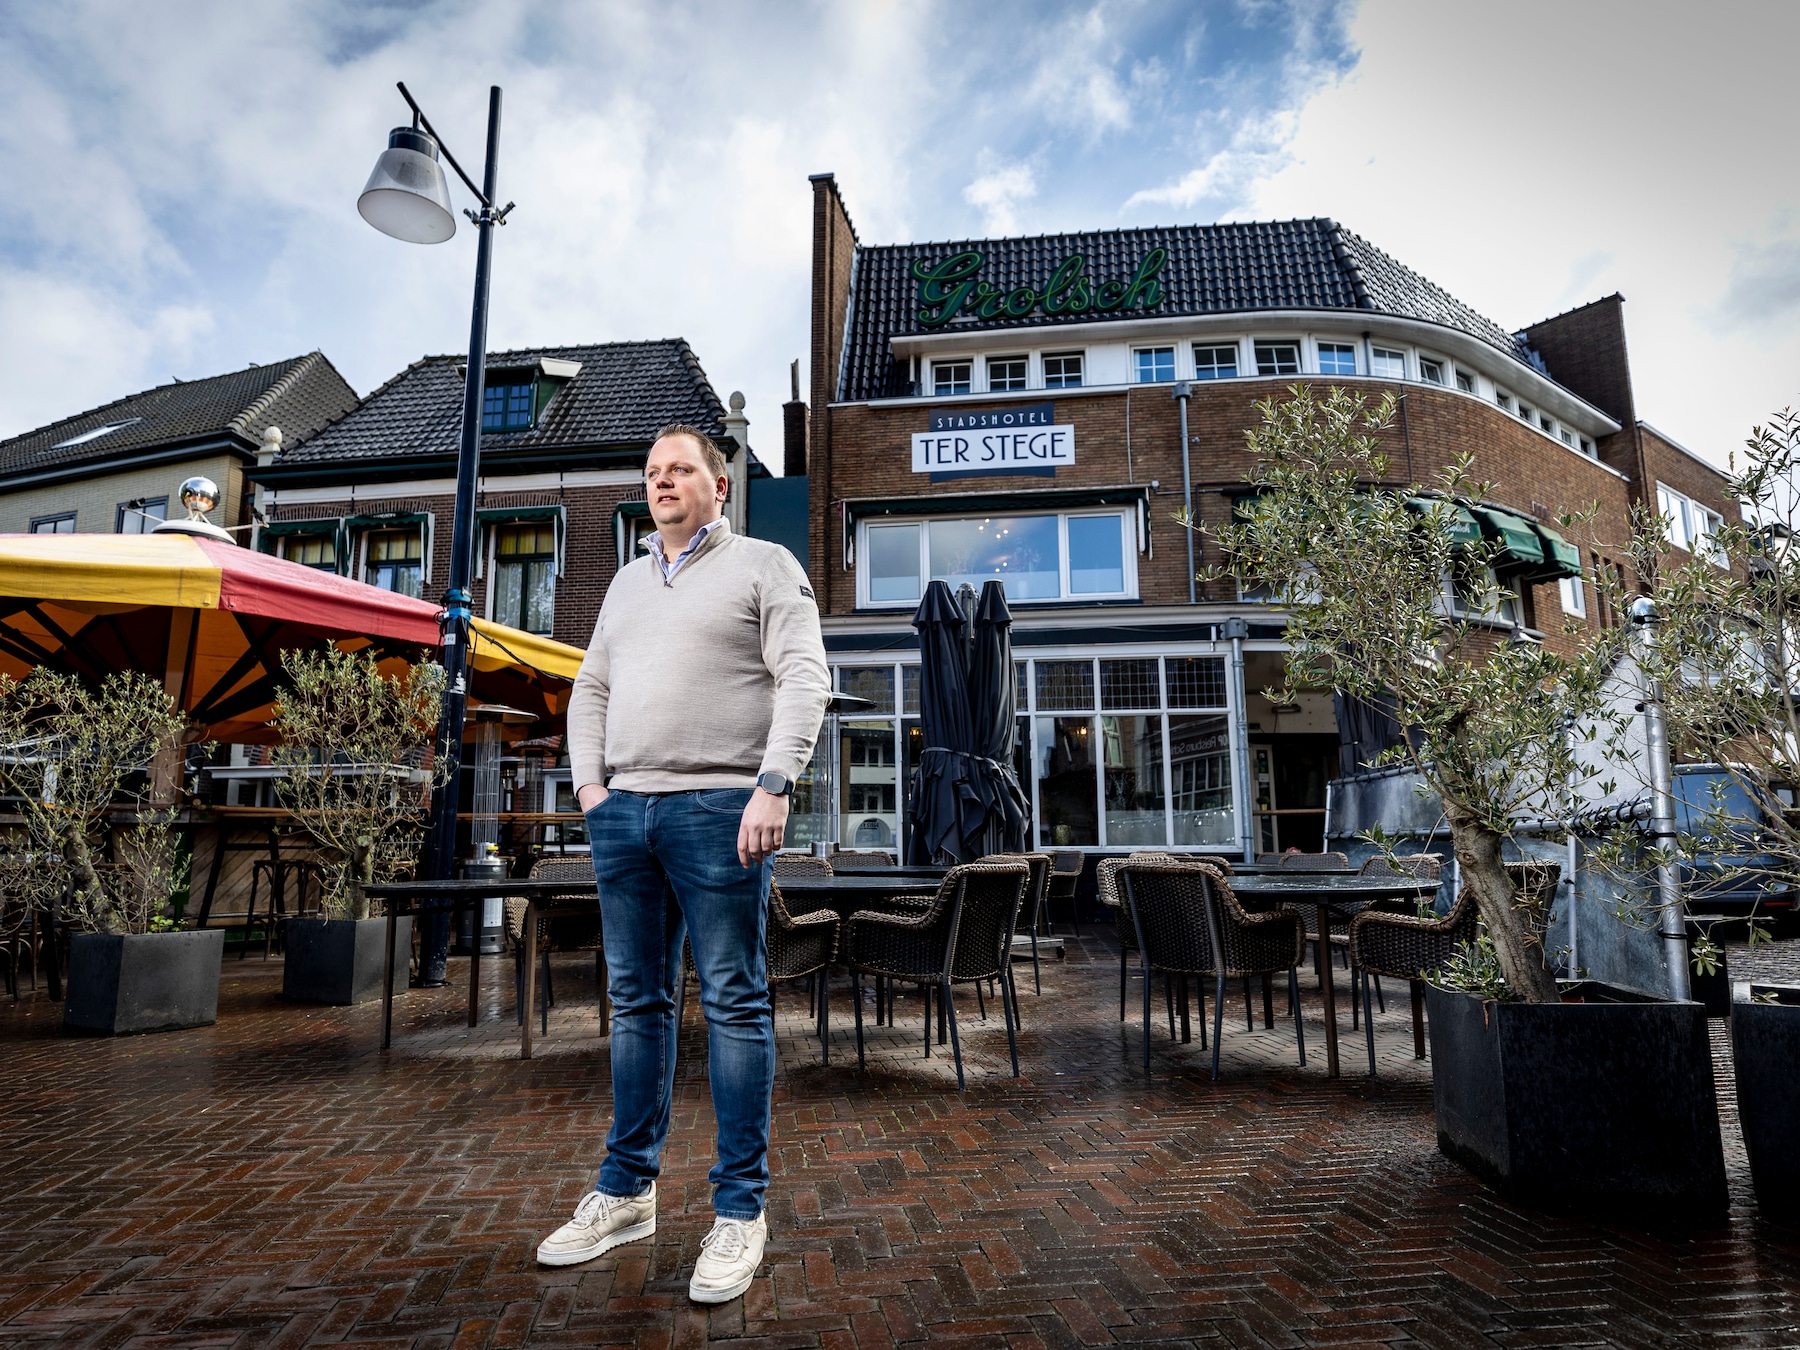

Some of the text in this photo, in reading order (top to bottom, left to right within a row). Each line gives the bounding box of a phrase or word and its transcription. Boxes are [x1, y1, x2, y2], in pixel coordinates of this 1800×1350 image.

[912, 248, 1168, 327] Grolsch
[937, 412, 1048, 429] STADSHOTEL
[919, 432, 1067, 465] TER STEGE
